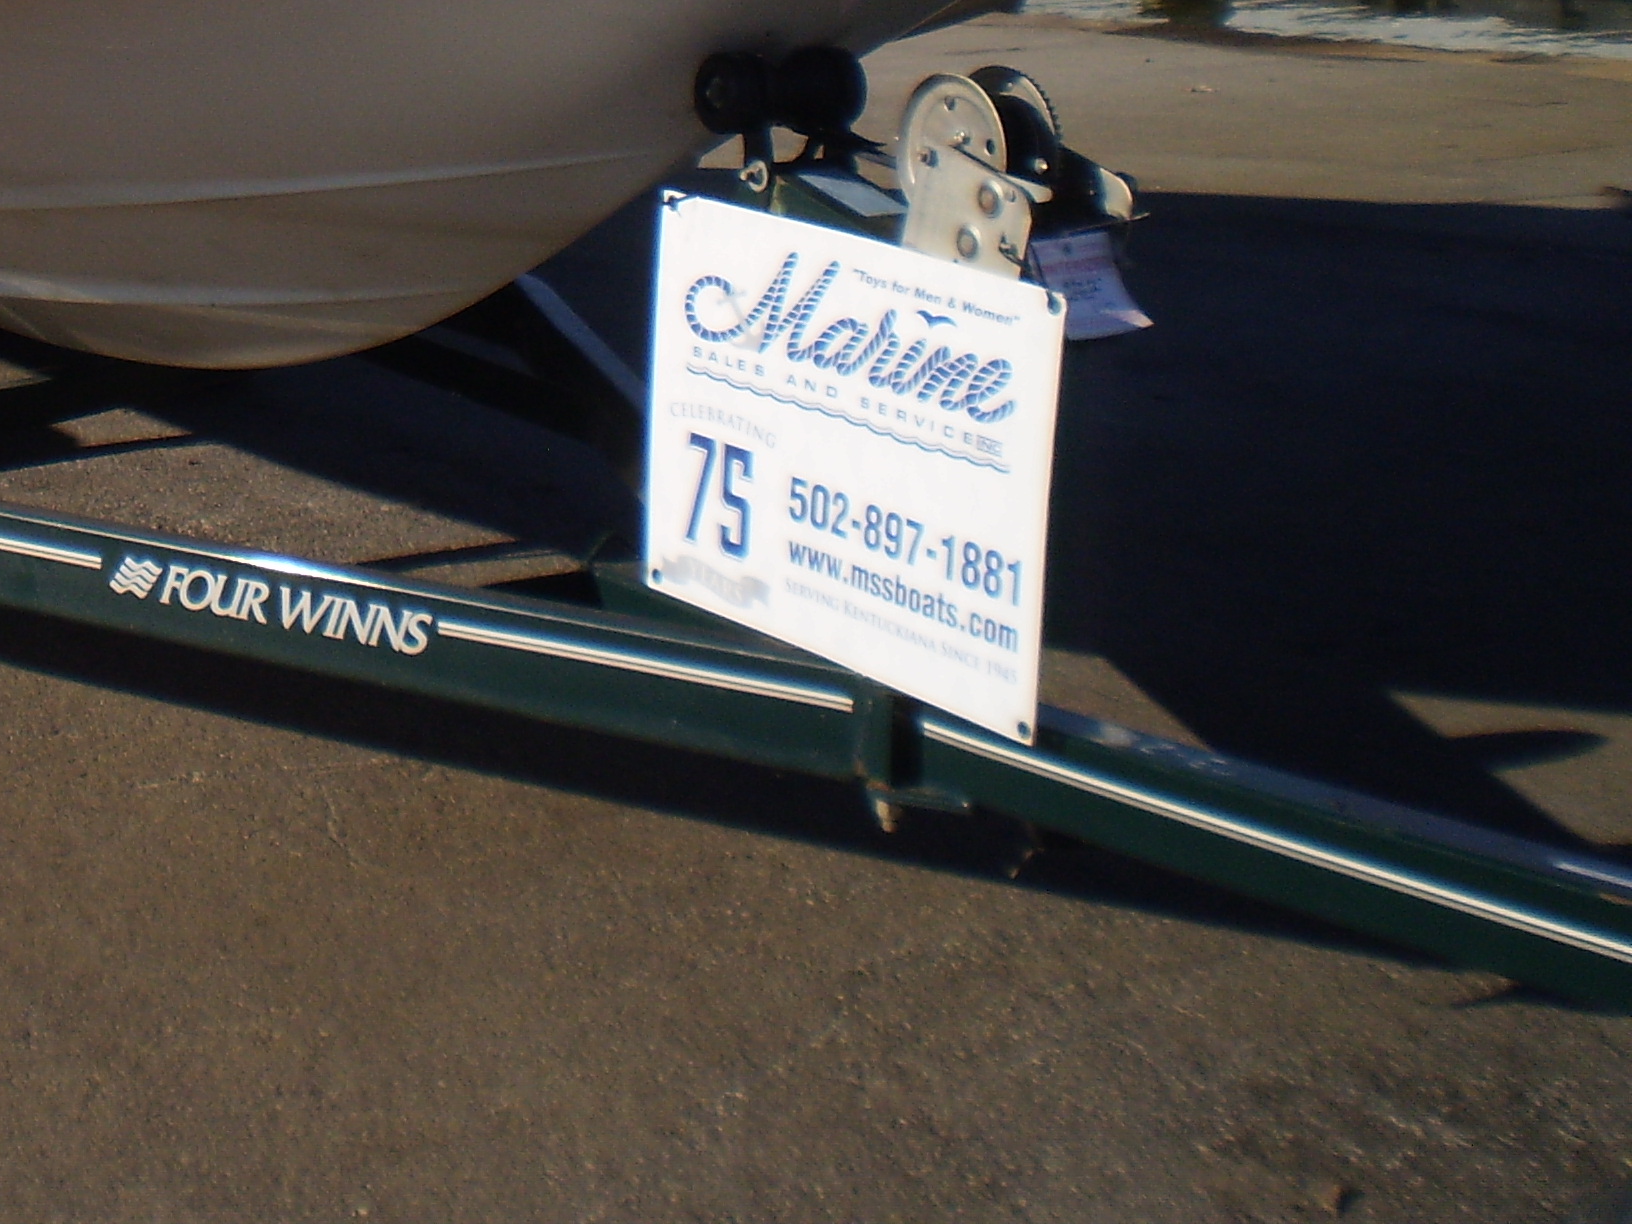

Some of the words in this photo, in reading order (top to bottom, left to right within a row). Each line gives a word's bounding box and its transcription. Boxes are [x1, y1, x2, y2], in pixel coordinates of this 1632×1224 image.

[683, 250, 1017, 424] Marine
[892, 280, 911, 295] for
[914, 287, 942, 305] Men
[947, 297, 956, 309] &
[669, 402, 777, 449] CELEBRATING
[692, 345, 767, 378] SALES
[786, 373, 839, 399] AND
[859, 396, 974, 445] SERVICE
[684, 431, 755, 561] 75
[788, 475, 1022, 607] 502-897-1881
[159, 564, 270, 625] FOUR
[279, 585, 434, 656] WINNS
[784, 577, 839, 611] SERVING
[940, 639, 980, 670] SINCE
[788, 538, 1019, 654] www.mssboats.com
